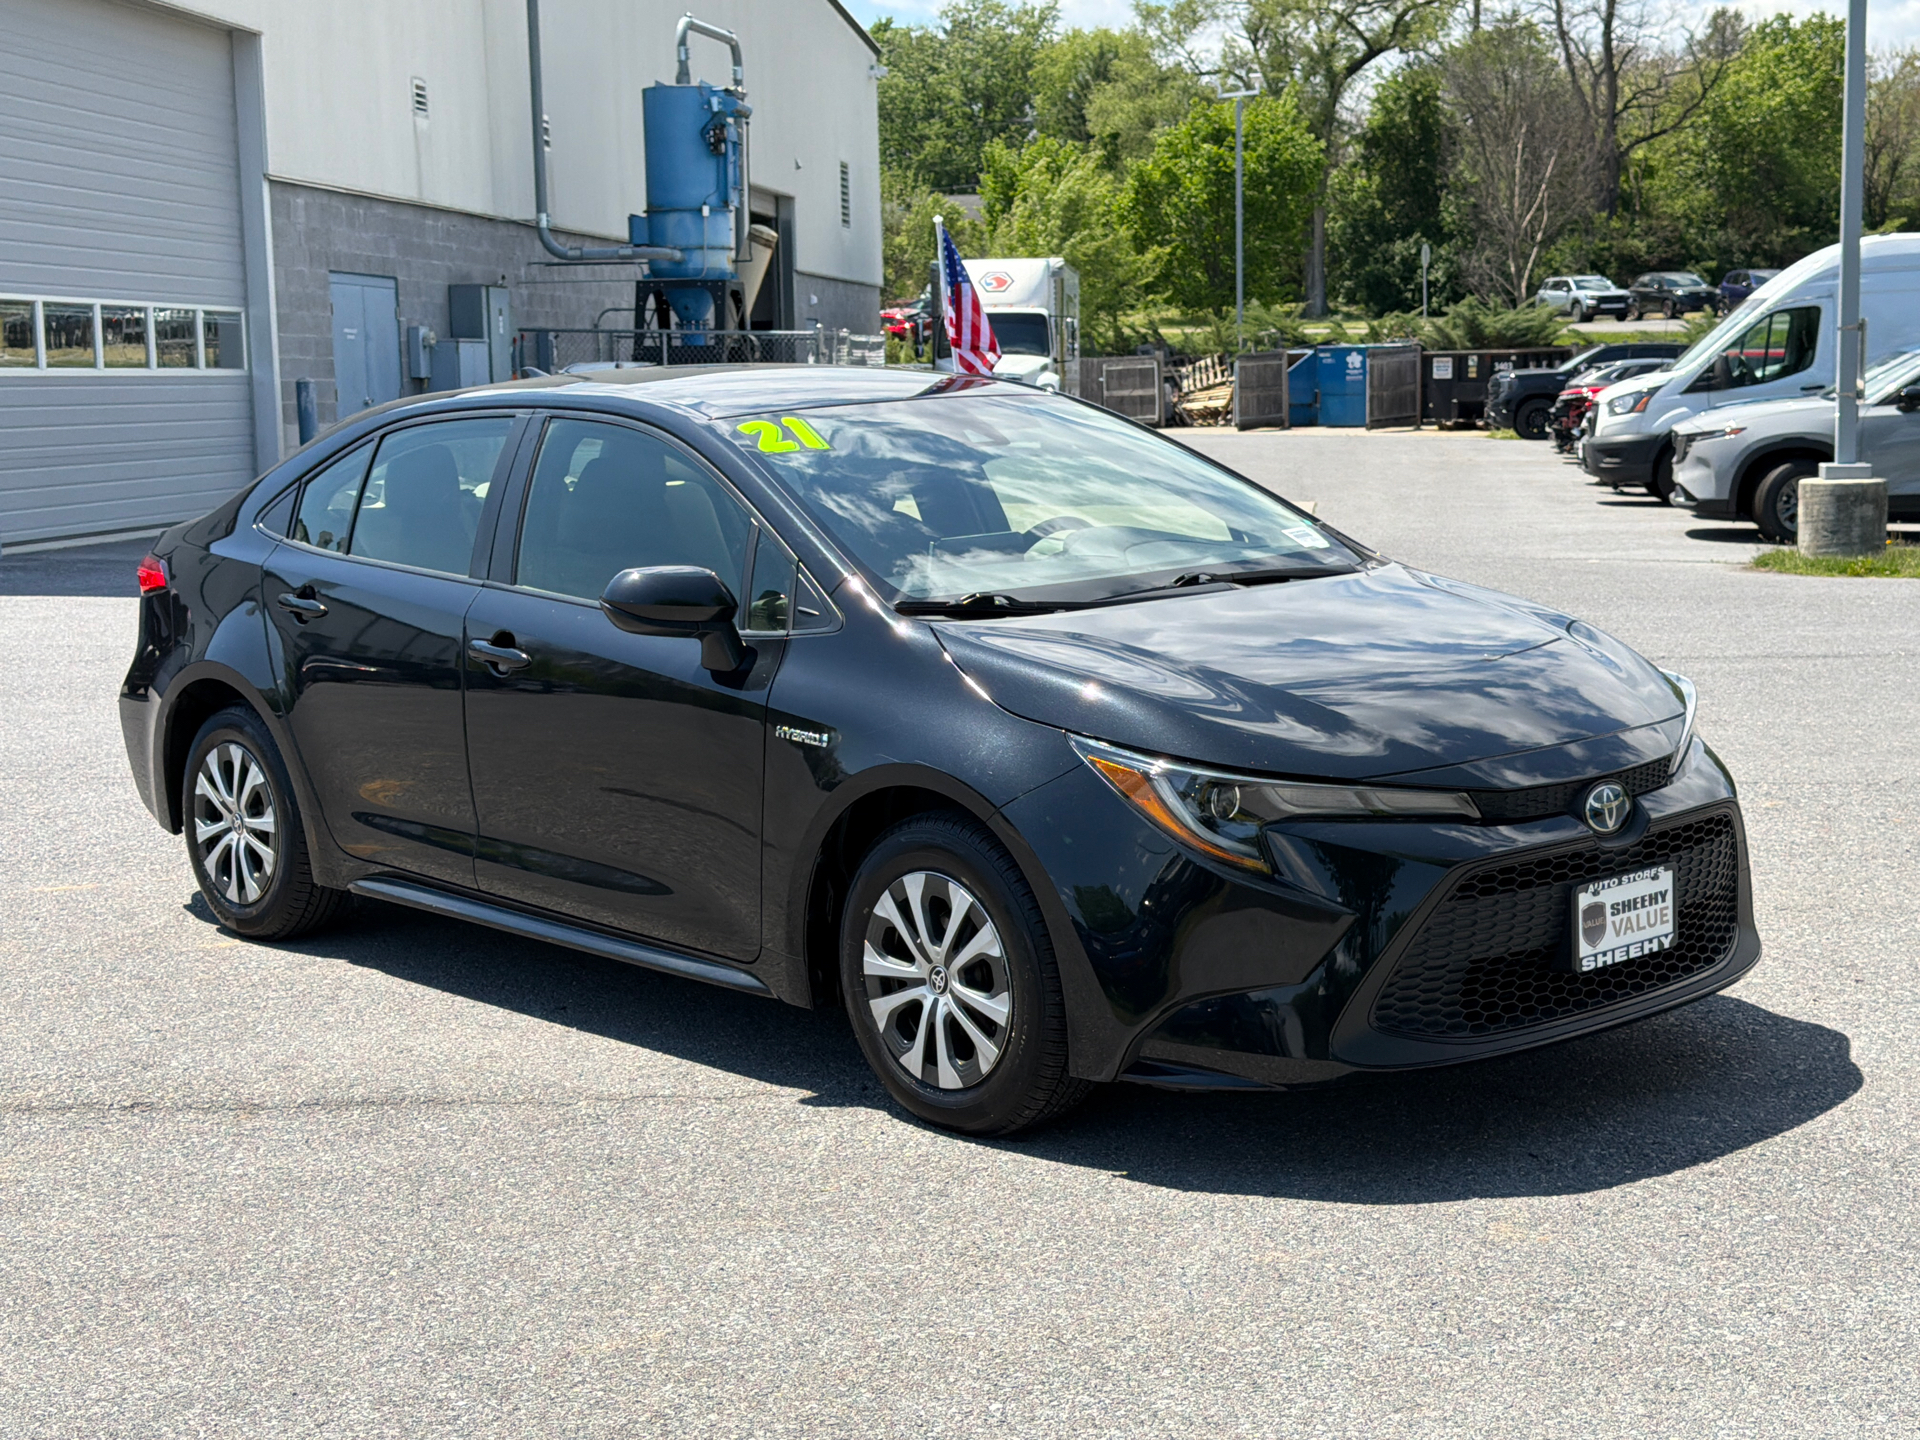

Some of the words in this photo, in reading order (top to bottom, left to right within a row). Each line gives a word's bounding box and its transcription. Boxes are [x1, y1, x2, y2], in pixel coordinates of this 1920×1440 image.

[736, 416, 830, 453] 21
[775, 725, 822, 746] HYBRID
[1587, 878, 1618, 894] AUTO
[1621, 866, 1665, 885] STORES
[1610, 889, 1669, 917] SHEEHY
[1582, 916, 1605, 929] VALUE
[1611, 906, 1670, 937] VALUE
[1581, 933, 1674, 971] SHEEHY
